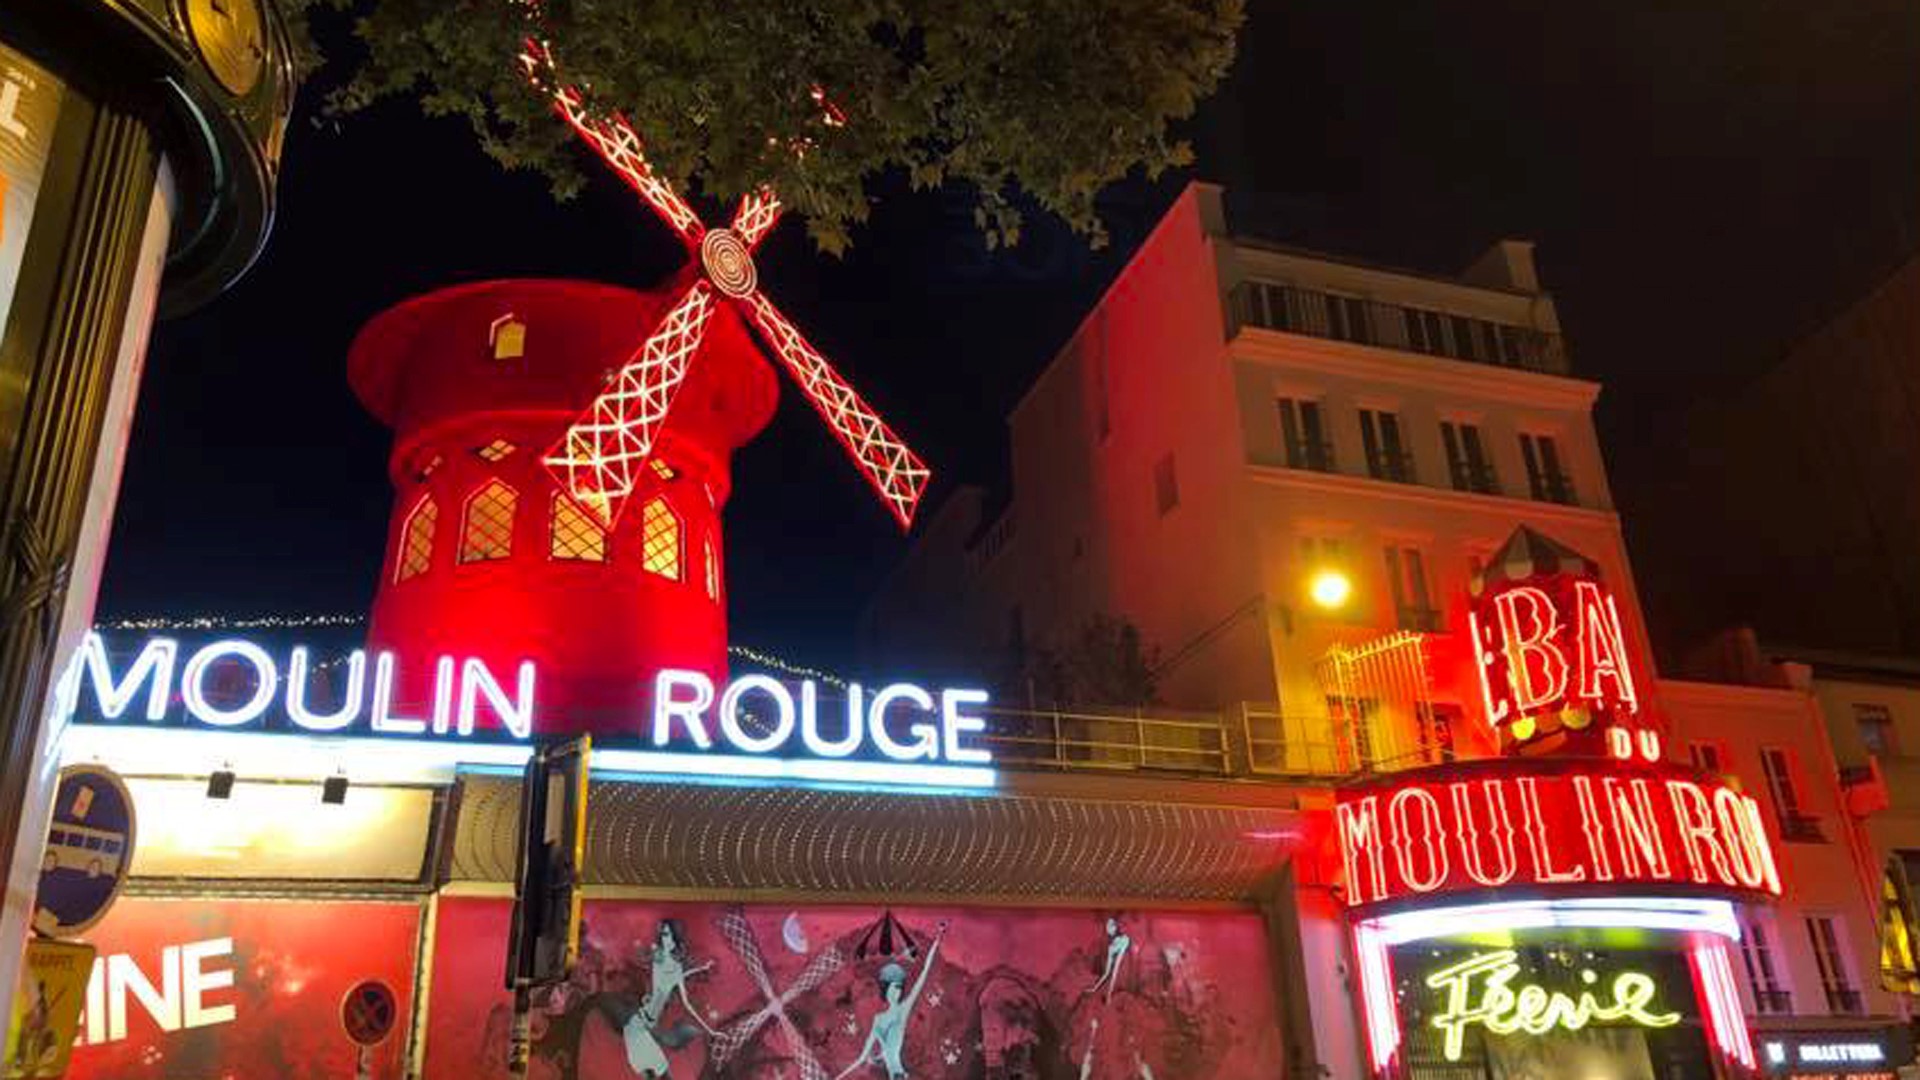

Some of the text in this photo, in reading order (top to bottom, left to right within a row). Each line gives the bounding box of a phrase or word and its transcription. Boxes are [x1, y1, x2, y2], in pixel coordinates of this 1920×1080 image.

[68, 629, 993, 763] MOULIN ROUGE
[1608, 726, 1661, 763] DU
[1336, 776, 1672, 906] MOULIN
[73, 937, 236, 1046] INE
